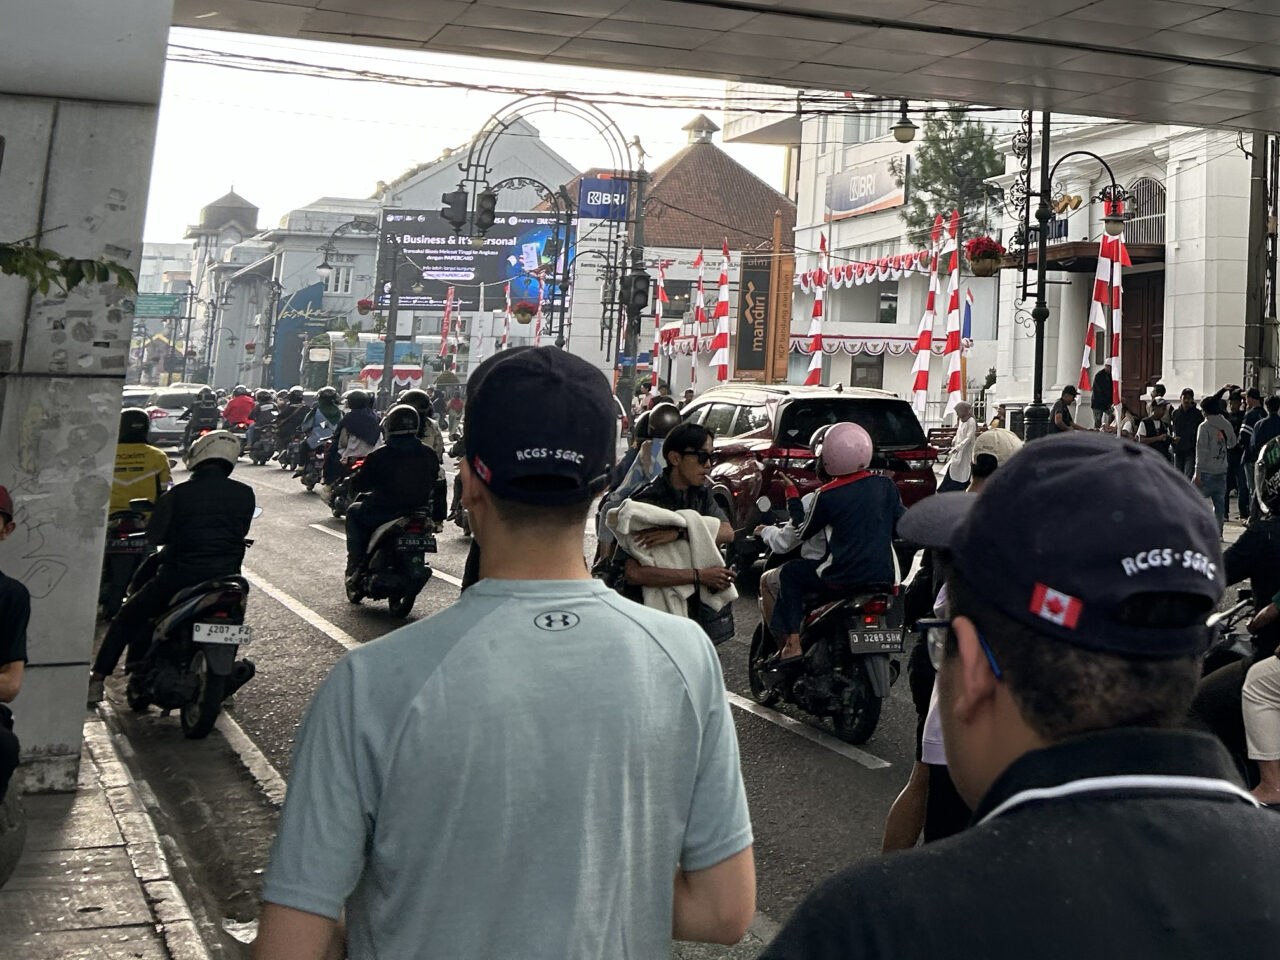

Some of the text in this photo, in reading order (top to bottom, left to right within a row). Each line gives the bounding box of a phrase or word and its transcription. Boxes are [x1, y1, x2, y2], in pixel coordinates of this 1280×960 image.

[859, 173, 876, 197] BRI
[602, 193, 625, 205] BRI
[403, 234, 446, 245] Business
[447, 235, 456, 245] &
[482, 236, 517, 246] ersonal
[752, 296, 766, 352] mandiri
[195, 624, 201, 632] D
[208, 625, 230, 634] 4207
[853, 634, 858, 643] D
